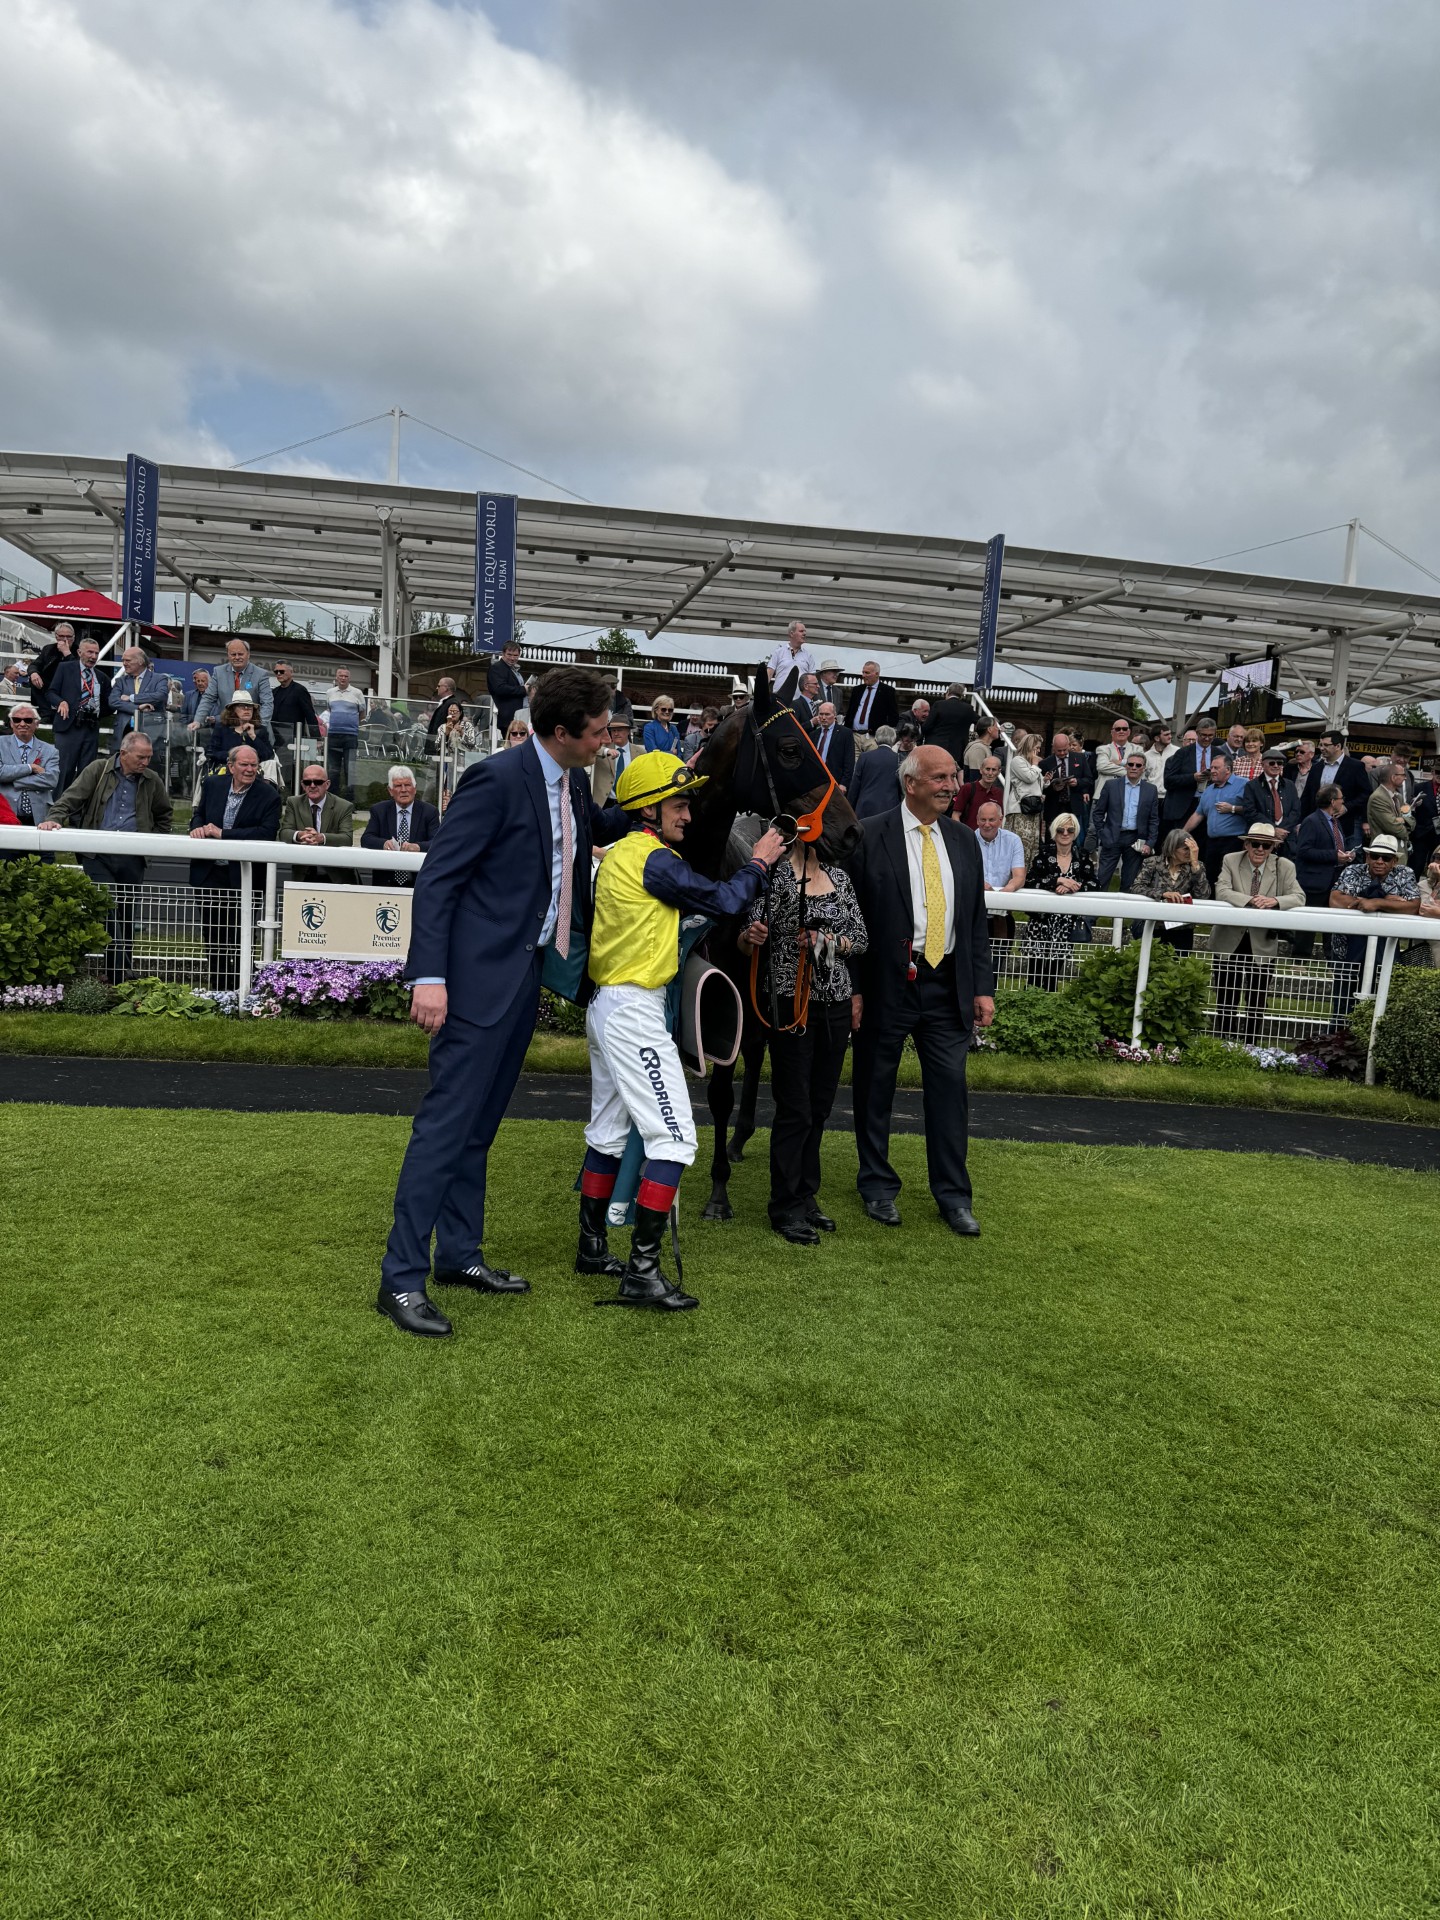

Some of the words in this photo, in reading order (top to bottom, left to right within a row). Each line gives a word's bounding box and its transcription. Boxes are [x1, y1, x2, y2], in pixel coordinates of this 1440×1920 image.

[135, 465, 147, 552] EQUIWORLD
[484, 500, 498, 584] EQUIWORLD
[134, 557, 143, 593] BASTI
[499, 559, 507, 590] DUBAI
[133, 598, 142, 615] AL
[484, 590, 495, 624] BASTI
[484, 629, 494, 645] AL
[293, 664, 337, 677] GRIDDL
[297, 937, 328, 946] Raceday
[298, 930, 328, 939] Premier
[373, 934, 402, 942] Premier
[372, 940, 401, 949] Raceday
